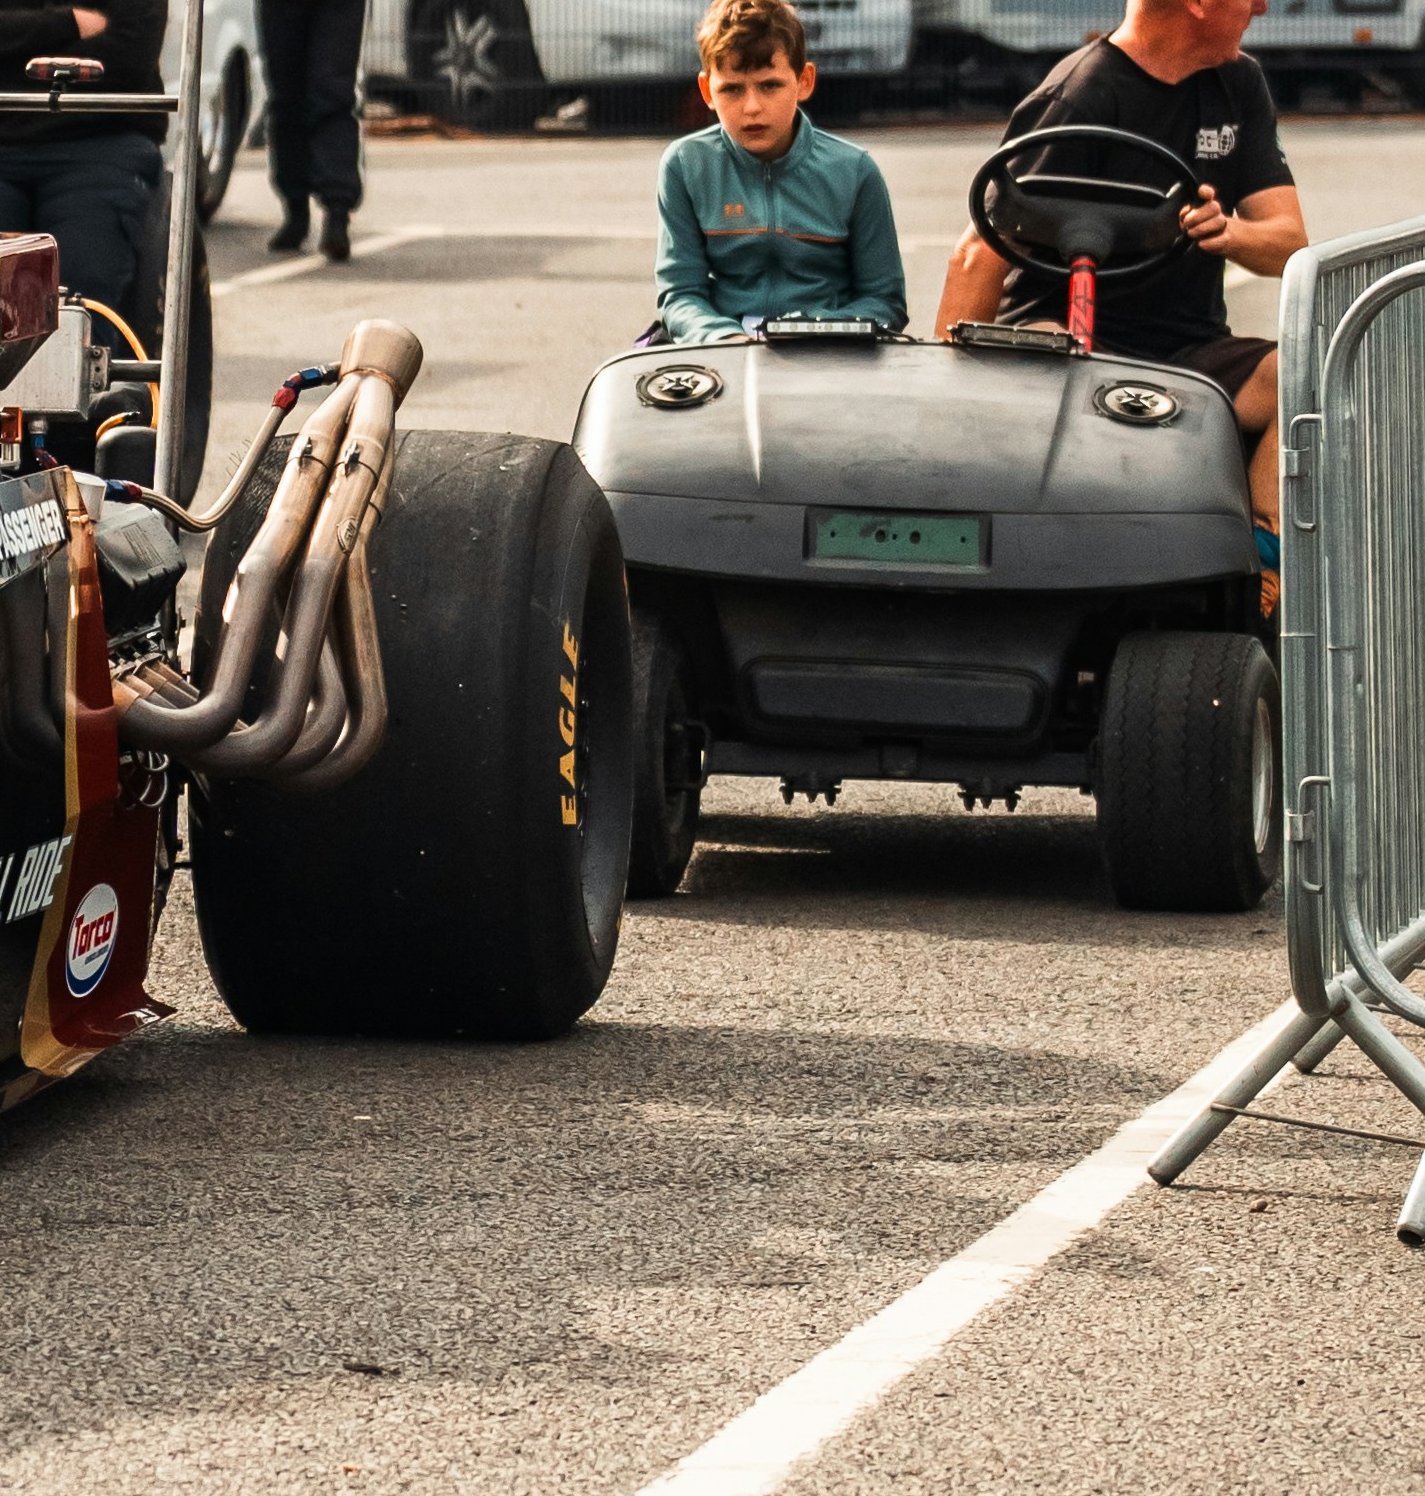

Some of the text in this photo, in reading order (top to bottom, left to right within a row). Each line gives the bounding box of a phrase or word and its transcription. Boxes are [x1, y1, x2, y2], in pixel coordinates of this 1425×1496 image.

[558, 621, 580, 826] EAGLE
[5, 834, 73, 925] RIDE
[71, 910, 115, 961] Torco
